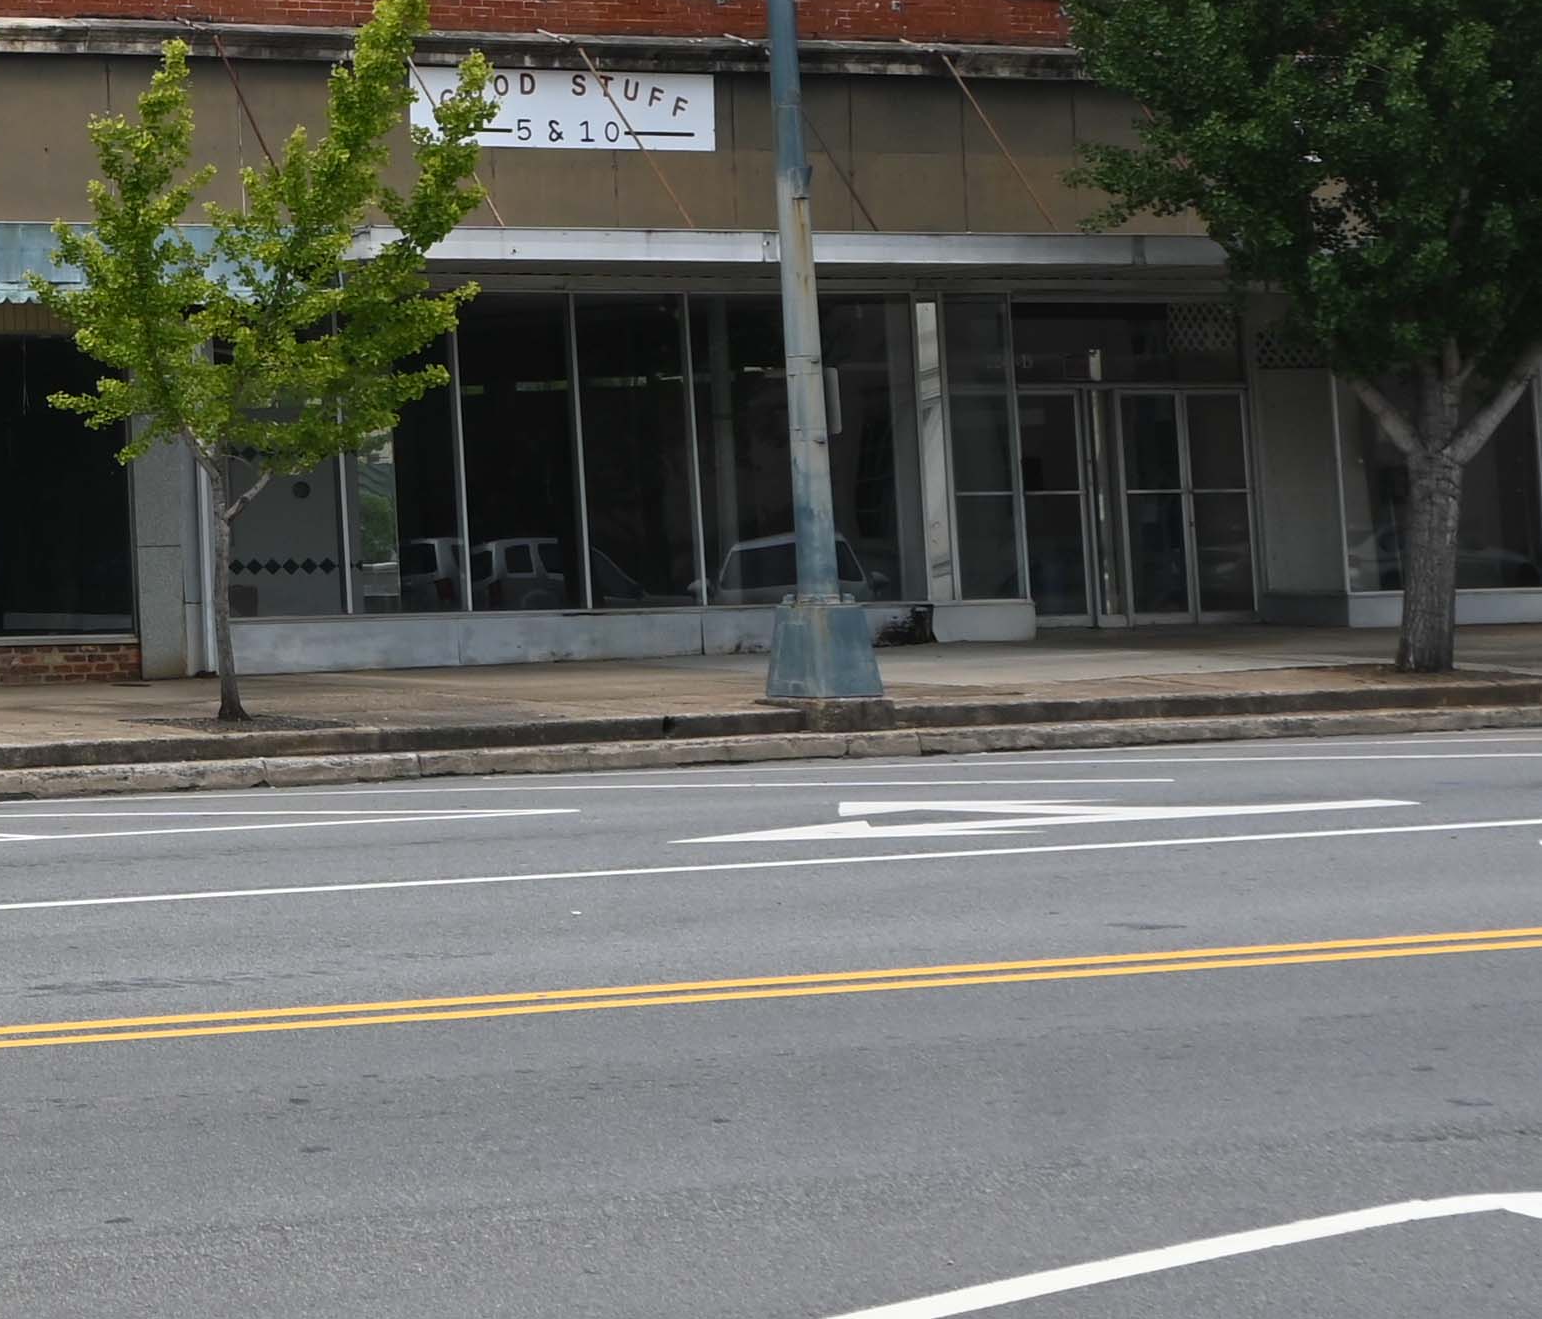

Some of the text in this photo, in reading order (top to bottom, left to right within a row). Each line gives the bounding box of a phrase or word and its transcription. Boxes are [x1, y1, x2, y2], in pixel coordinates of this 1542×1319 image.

[439, 73, 689, 117] GOD STUFF
[517, 118, 620, 143] 5 & 10
